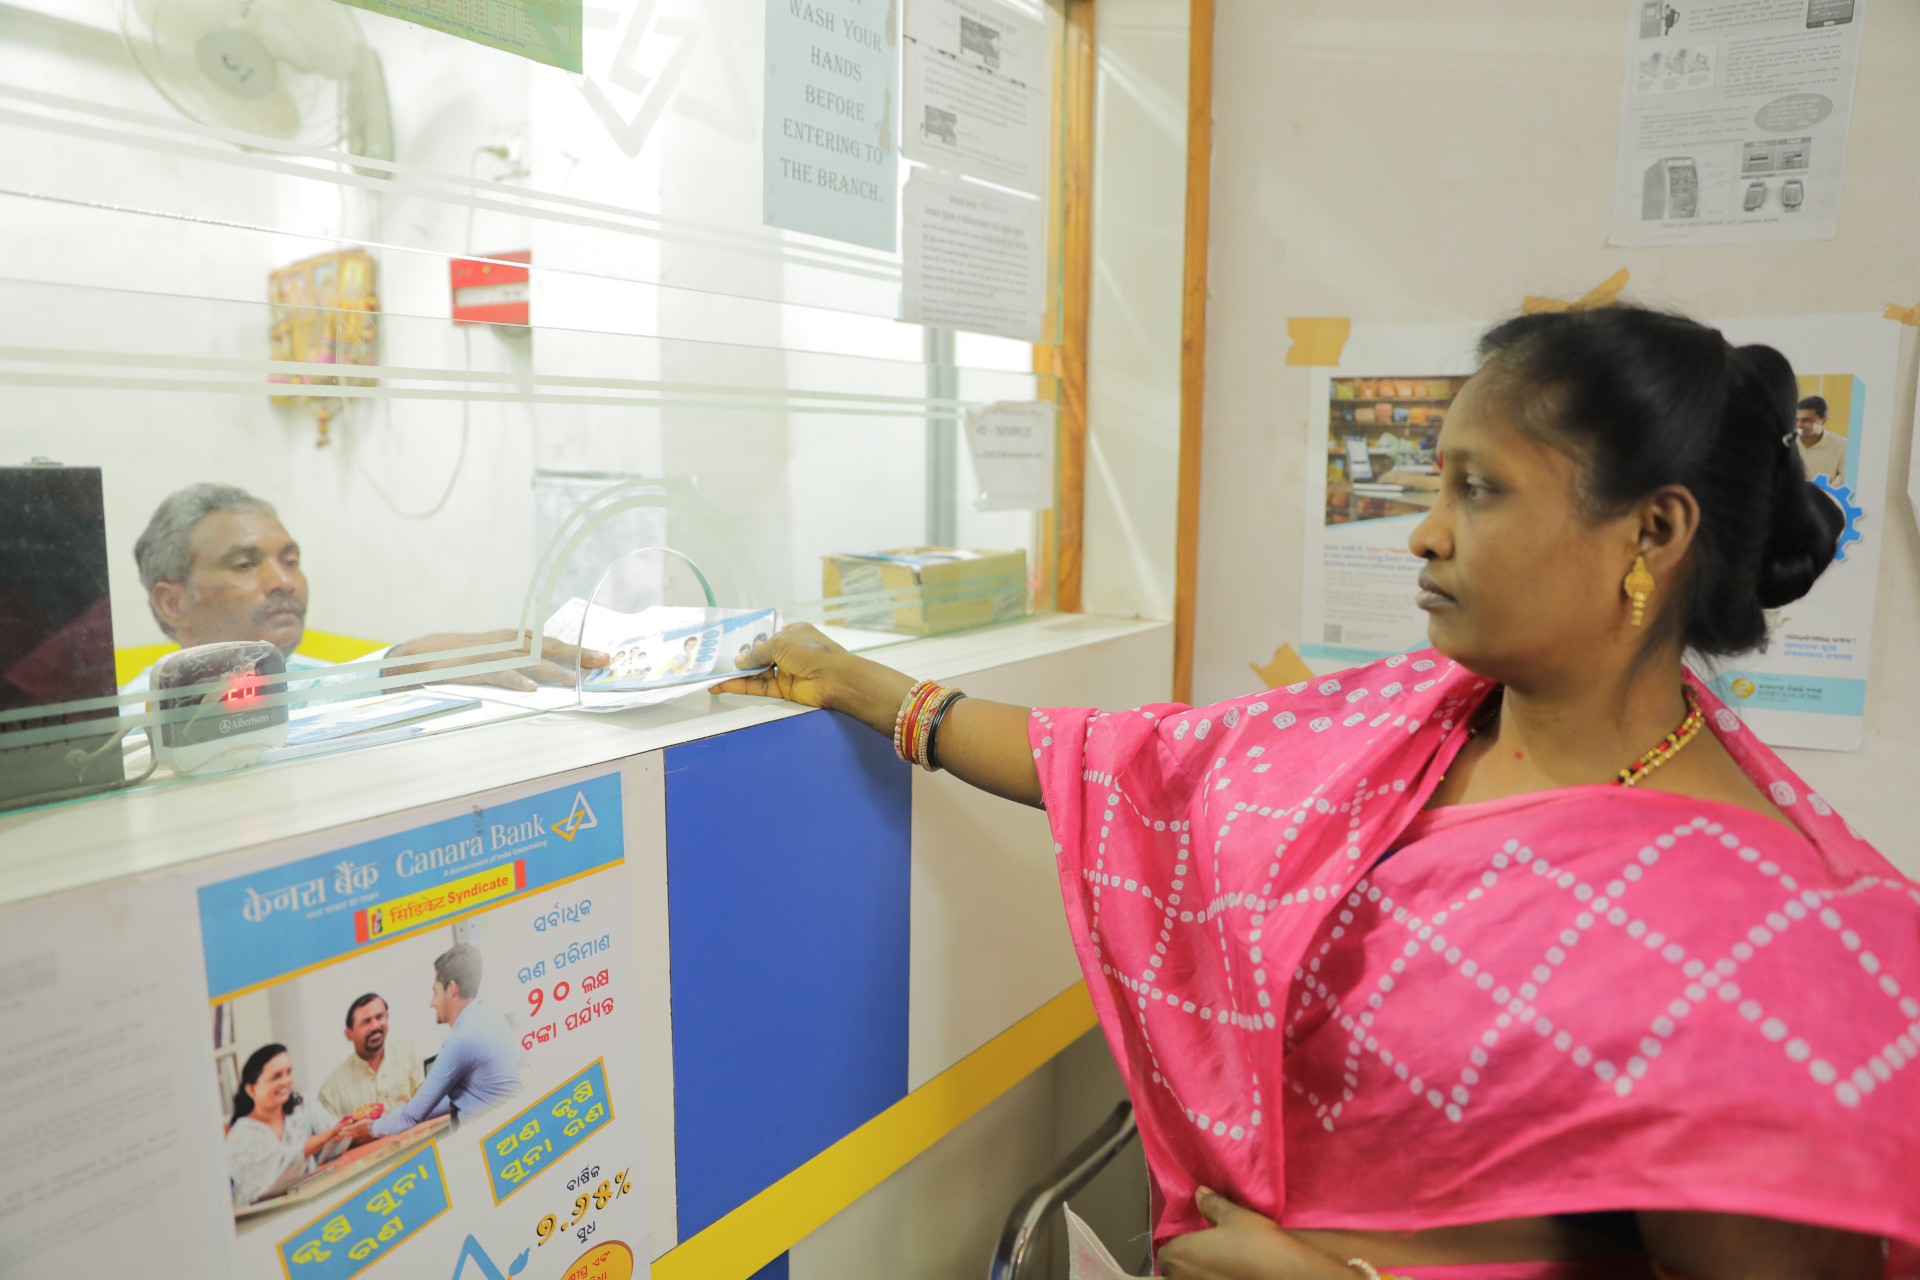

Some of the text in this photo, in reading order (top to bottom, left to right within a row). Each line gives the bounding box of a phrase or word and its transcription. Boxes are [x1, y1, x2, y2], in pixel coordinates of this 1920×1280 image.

[789, 0, 883, 53] WASH YOUR
[811, 45, 862, 81] HANDS
[804, 84, 866, 122] BEFORE
[783, 118, 860, 162] ENTERING
[864, 142, 883, 165] TO
[780, 157, 883, 203] THE BRANCH.
[231, 714, 270, 730] Albertsons
[395, 813, 547, 879] Canara Bank
[443, 839, 549, 878] A Government of India Undertaking
[243, 860, 380, 922] केनरा बैंक
[390, 874, 509, 924] सिंडिकेट Syndicate
[533, 899, 592, 932] ସର୍ବାଧିକ
[553, 934, 610, 970] ପରିମାଣ
[581, 968, 610, 994] ଲକ୍ଷ
[521, 1022, 557, 1051] ଟଙ୍କା
[496, 1079, 594, 1156] ଅଣ କୃଷି
[500, 1137, 553, 1184] ସୁନା
[291, 1164, 430, 1265] କୃଷି ସୁନା
[576, 1221, 596, 1244] ସୁଧ
